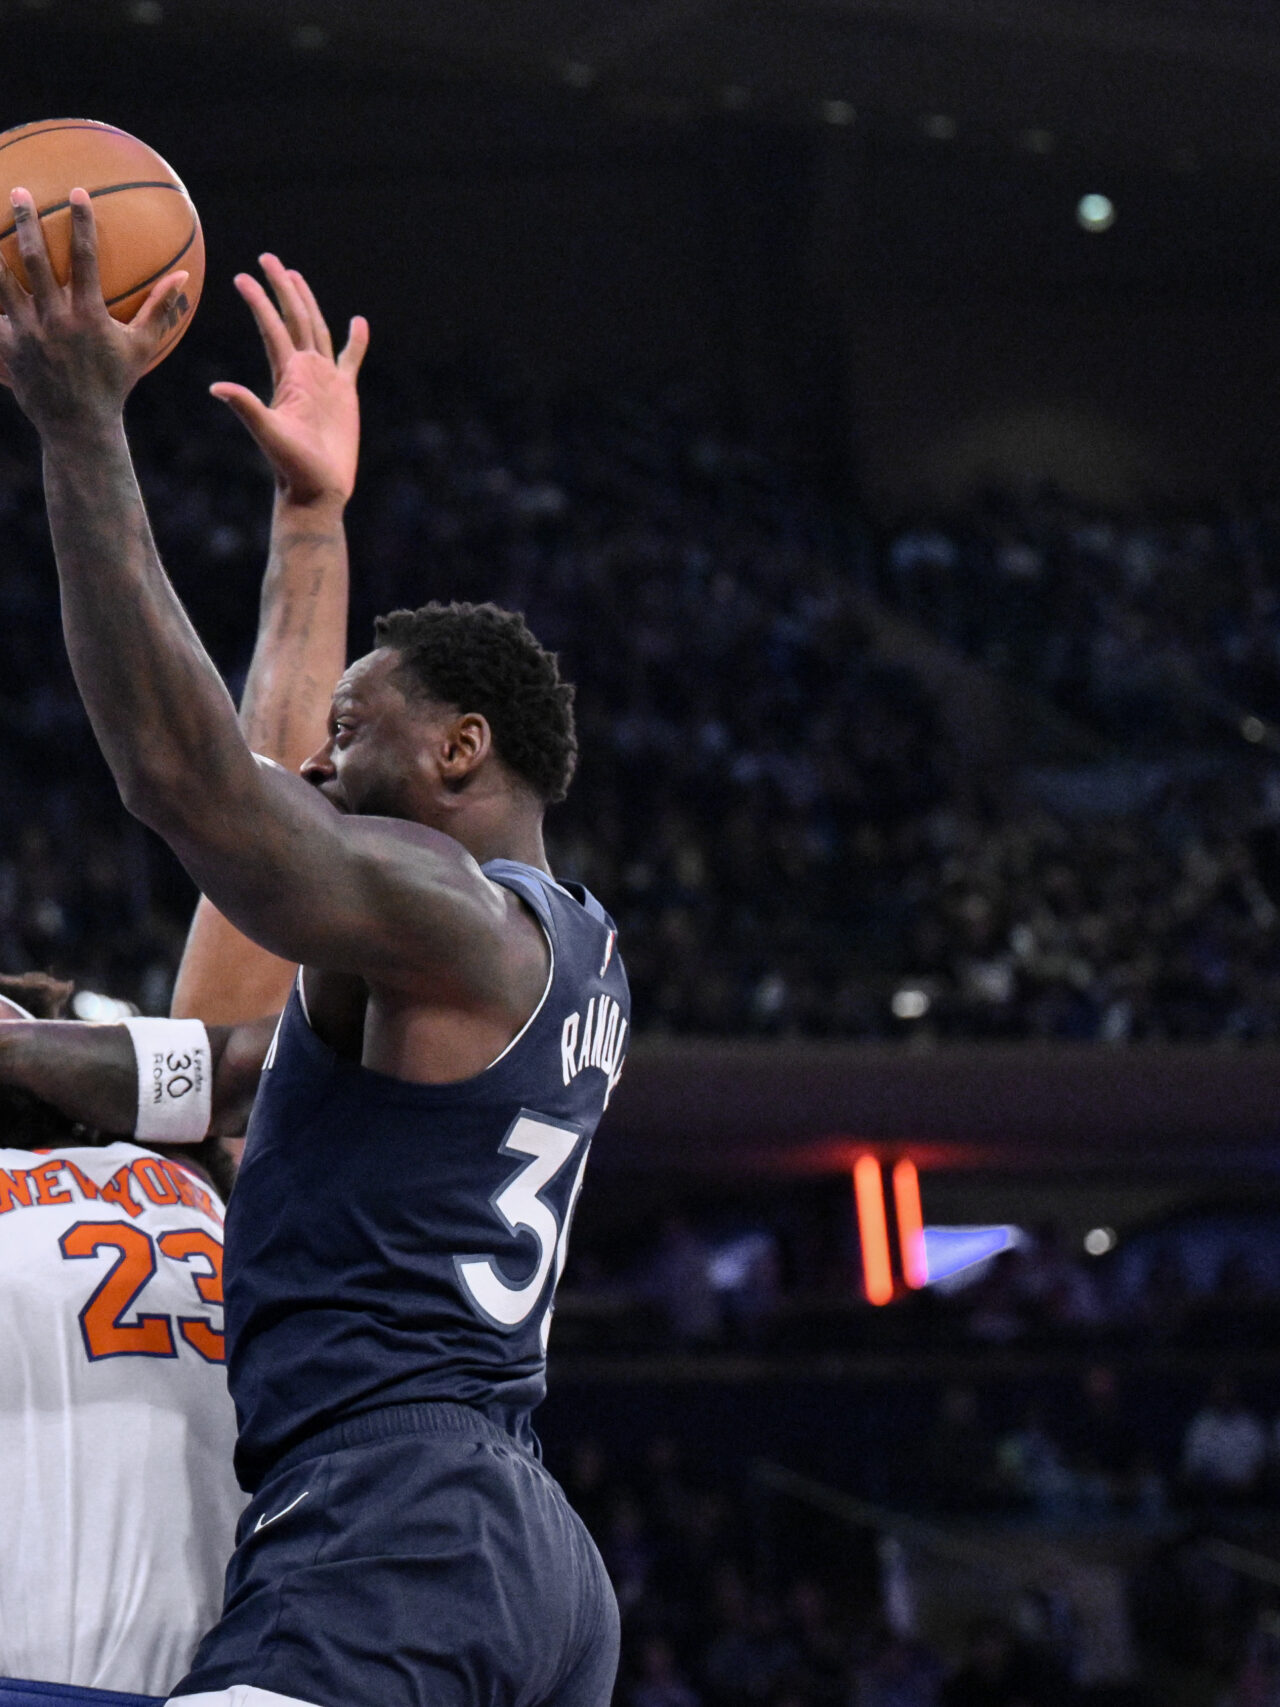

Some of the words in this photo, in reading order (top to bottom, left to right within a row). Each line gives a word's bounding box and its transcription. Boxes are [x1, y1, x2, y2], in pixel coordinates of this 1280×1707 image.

[167, 1052, 193, 1098] 30
[561, 993, 628, 1113] RANDL
[58, 1220, 226, 1365] 23
[453, 1107, 592, 1362] 3
